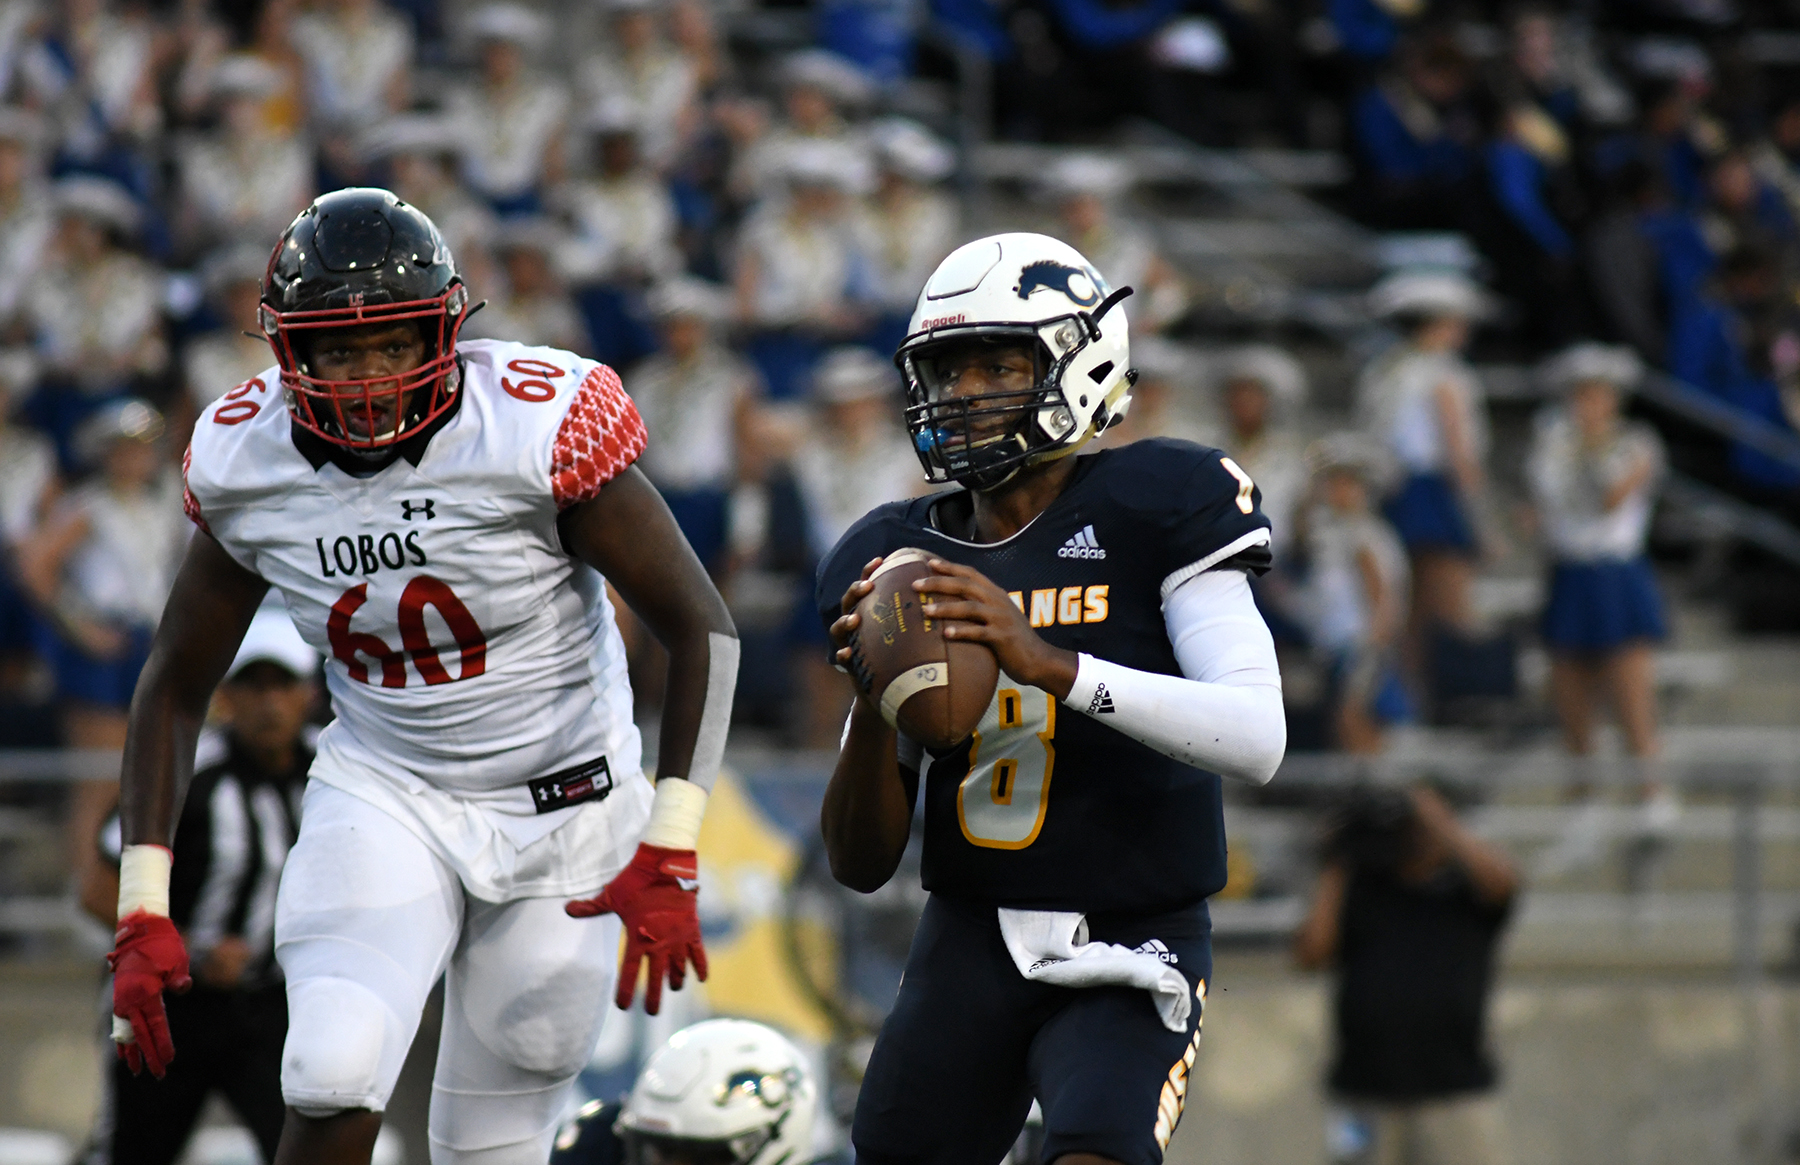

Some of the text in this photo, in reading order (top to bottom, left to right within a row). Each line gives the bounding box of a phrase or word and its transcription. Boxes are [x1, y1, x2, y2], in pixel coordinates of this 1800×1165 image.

[213, 377, 266, 426] 60
[501, 359, 565, 402] 60
[316, 530, 427, 577] LOBOS
[1057, 546, 1107, 560] adidas
[326, 575, 487, 689] 60
[1085, 682, 1105, 716] adidas
[957, 668, 1056, 850] 8
